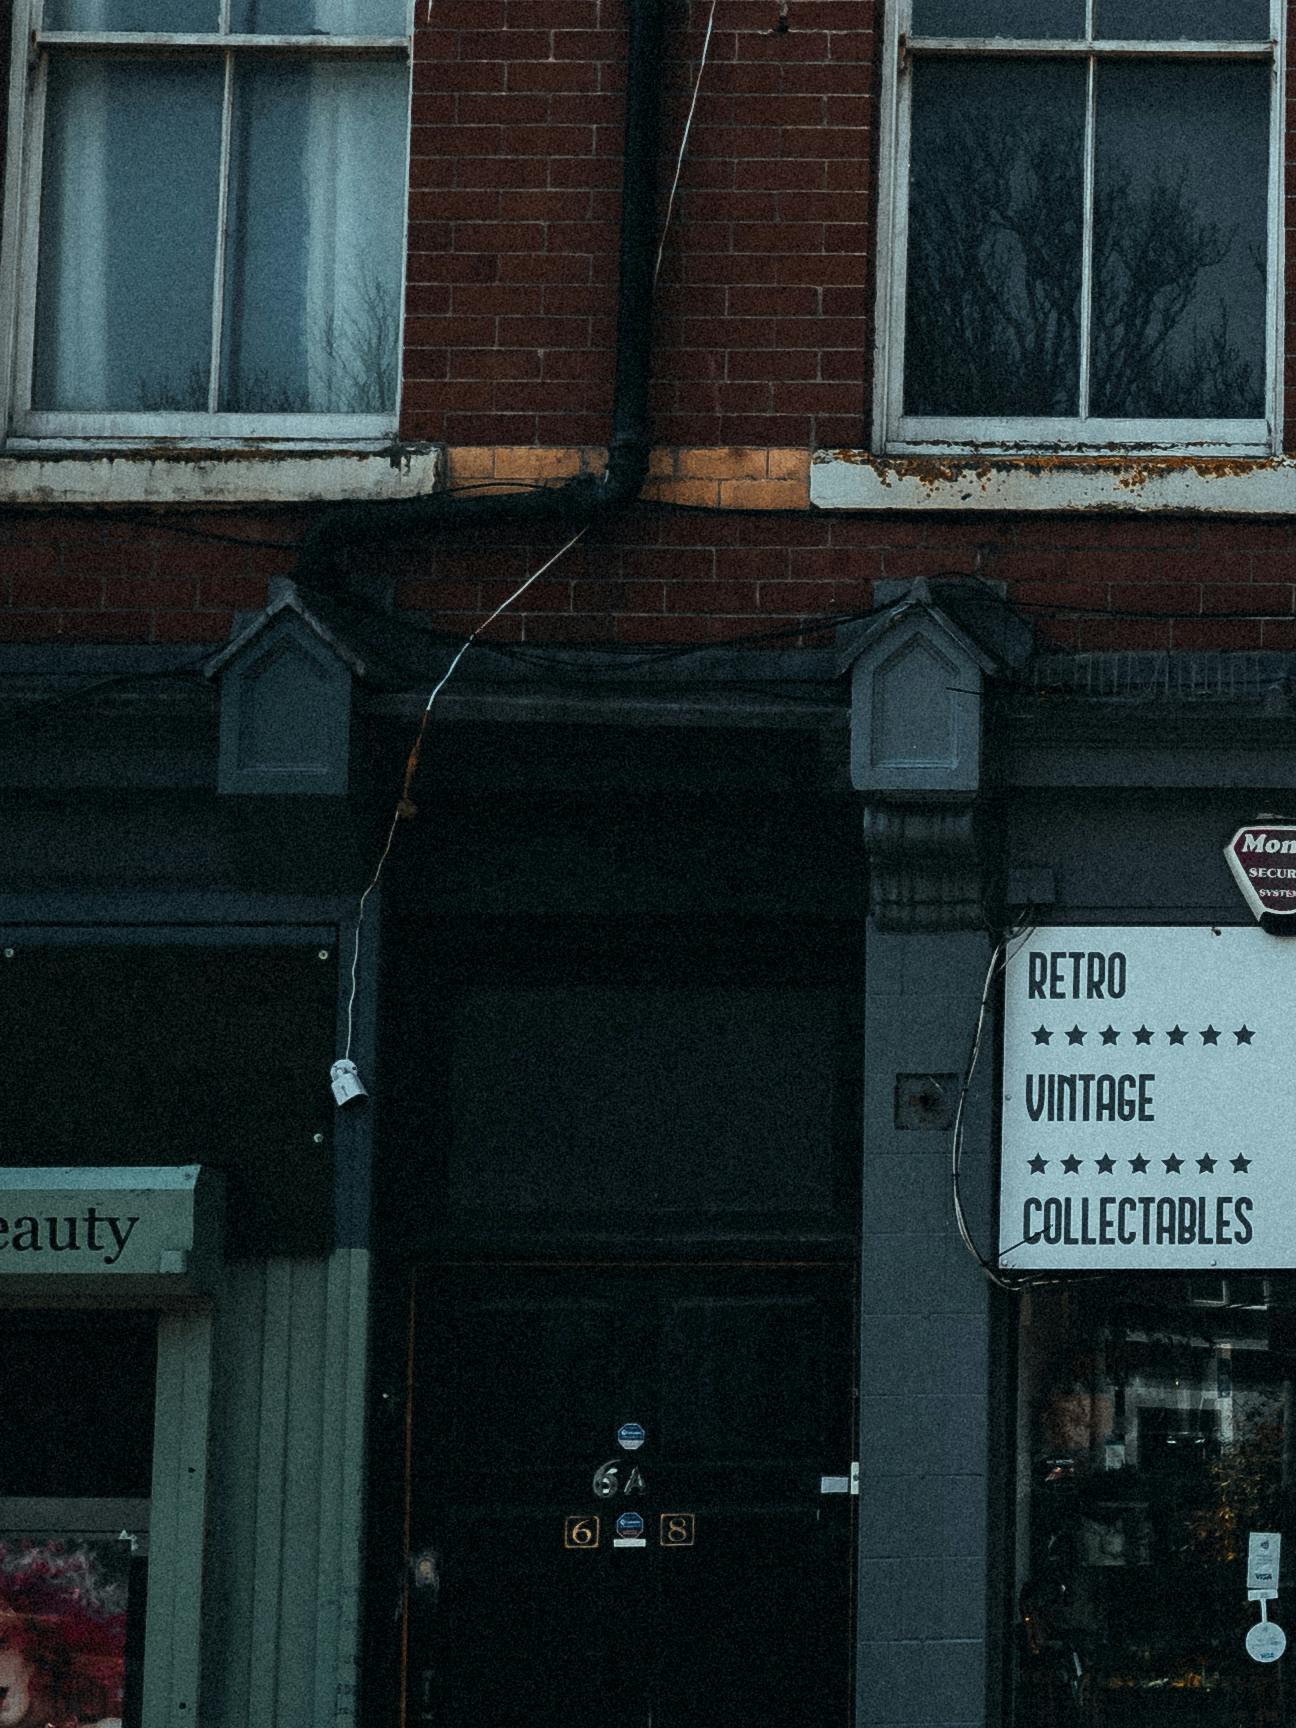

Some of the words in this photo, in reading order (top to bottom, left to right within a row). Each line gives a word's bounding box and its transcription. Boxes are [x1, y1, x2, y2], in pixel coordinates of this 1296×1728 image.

[1028, 951, 1127, 1000] RETRO
[1025, 1073, 1156, 1122] VINTAGE
[1022, 1196, 1254, 1246] COLLECTABLES
[572, 1519, 592, 1544] 6
[667, 1517, 688, 1542] 8
